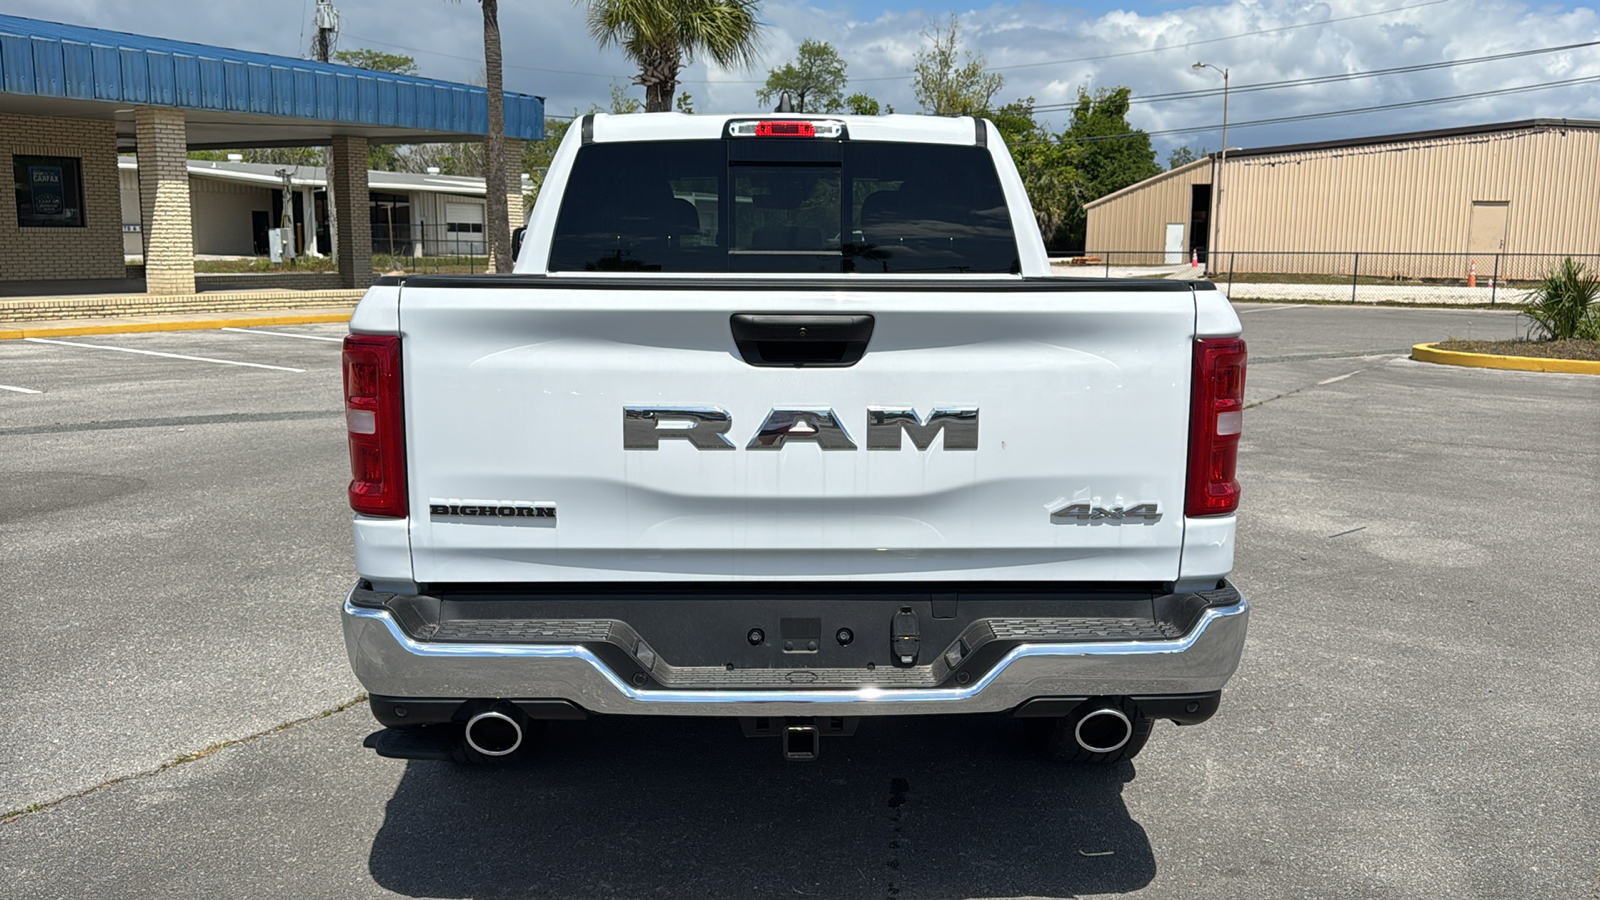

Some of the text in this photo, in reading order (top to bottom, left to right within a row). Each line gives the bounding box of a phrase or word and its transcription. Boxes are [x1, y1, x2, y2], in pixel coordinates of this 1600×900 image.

[33, 174, 59, 182] CARFAX
[622, 404, 980, 451] RAM
[429, 502, 557, 522] BIGHORN
